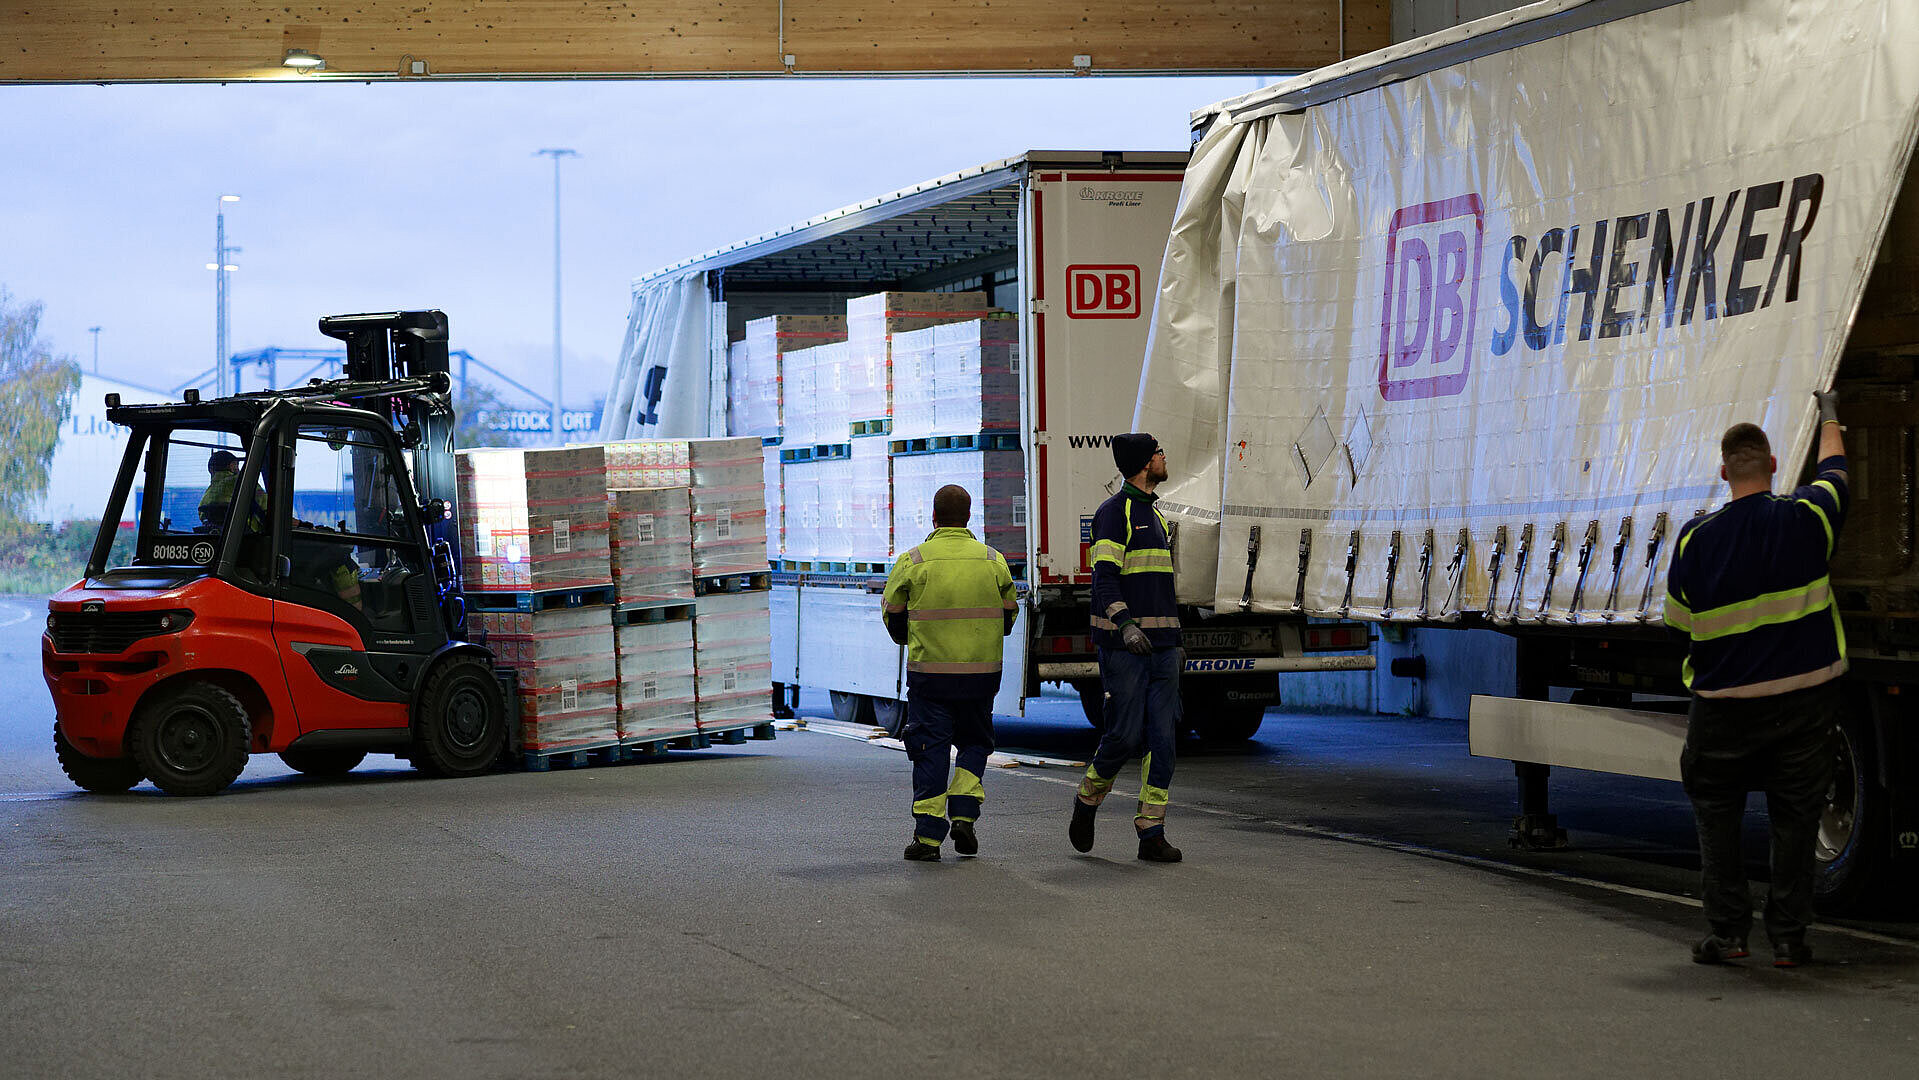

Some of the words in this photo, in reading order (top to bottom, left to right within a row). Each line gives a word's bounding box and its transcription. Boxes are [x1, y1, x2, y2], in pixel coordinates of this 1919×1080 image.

[1390, 227, 1470, 371] DB
[1490, 172, 1825, 356] SCHENKER
[1075, 272, 1133, 311] DB
[72, 414, 132, 440] Lloy
[562, 411, 594, 431] ORT
[153, 544, 189, 559] 801835
[194, 547, 211, 558] FSN
[334, 663, 359, 675] Linde
[1185, 659, 1256, 671] KRONE
